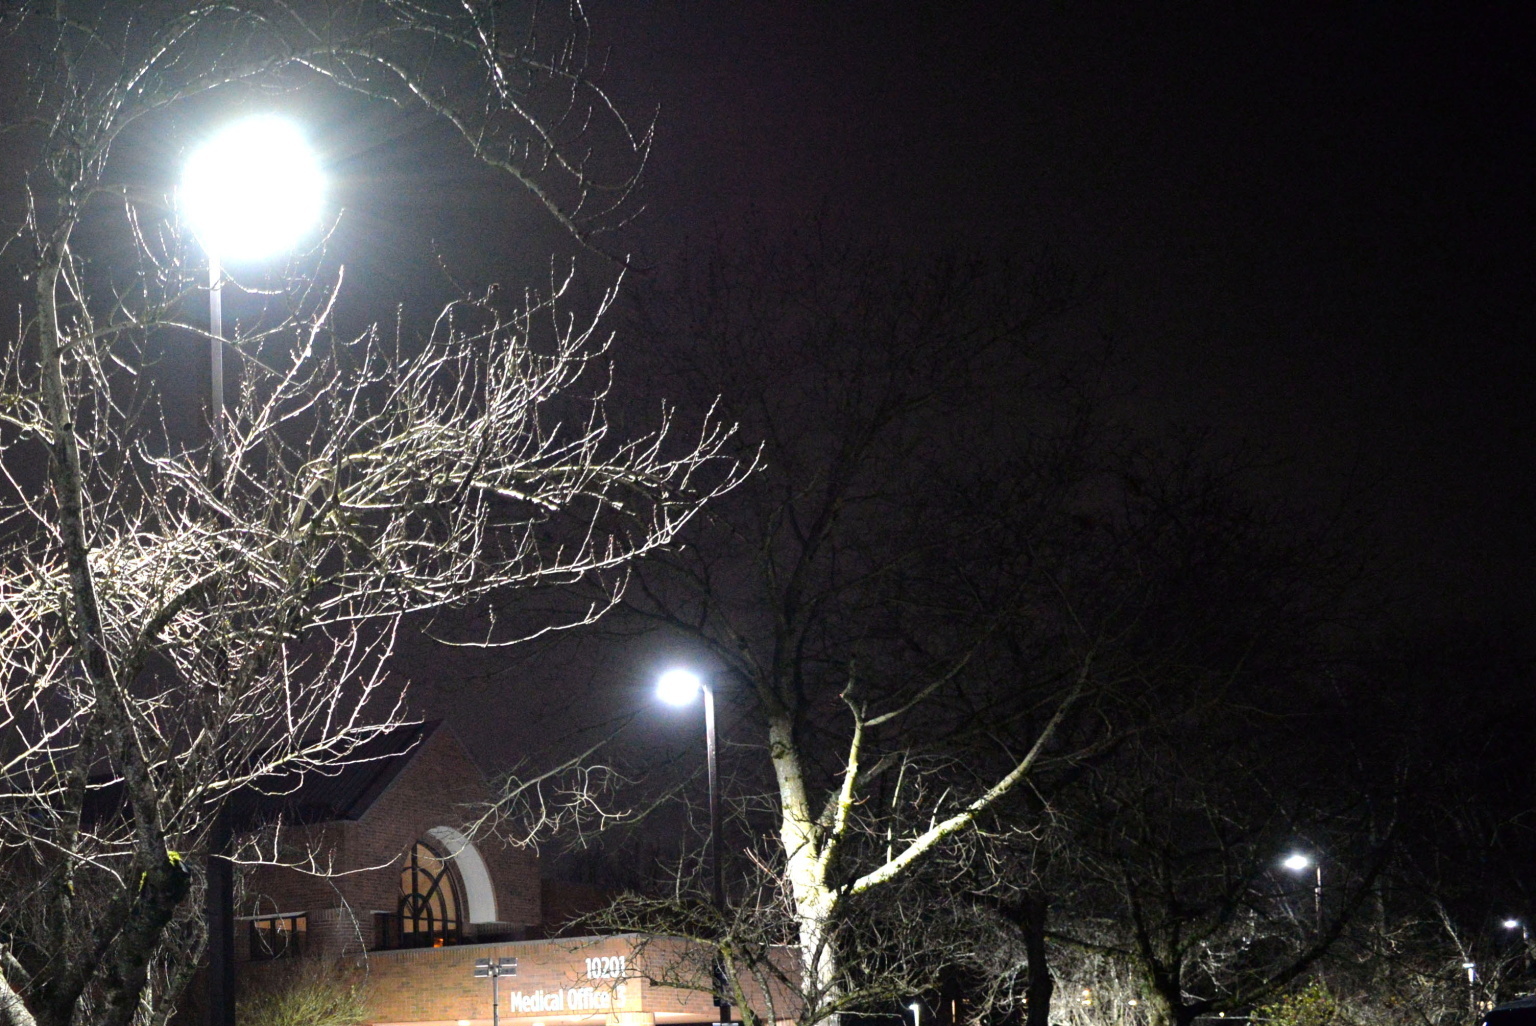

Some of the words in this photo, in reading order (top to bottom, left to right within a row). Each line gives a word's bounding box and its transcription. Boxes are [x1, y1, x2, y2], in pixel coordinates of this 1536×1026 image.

[585, 955, 626, 979] 10201
[510, 989, 564, 1012] Medical
[567, 986, 610, 1010] Office
